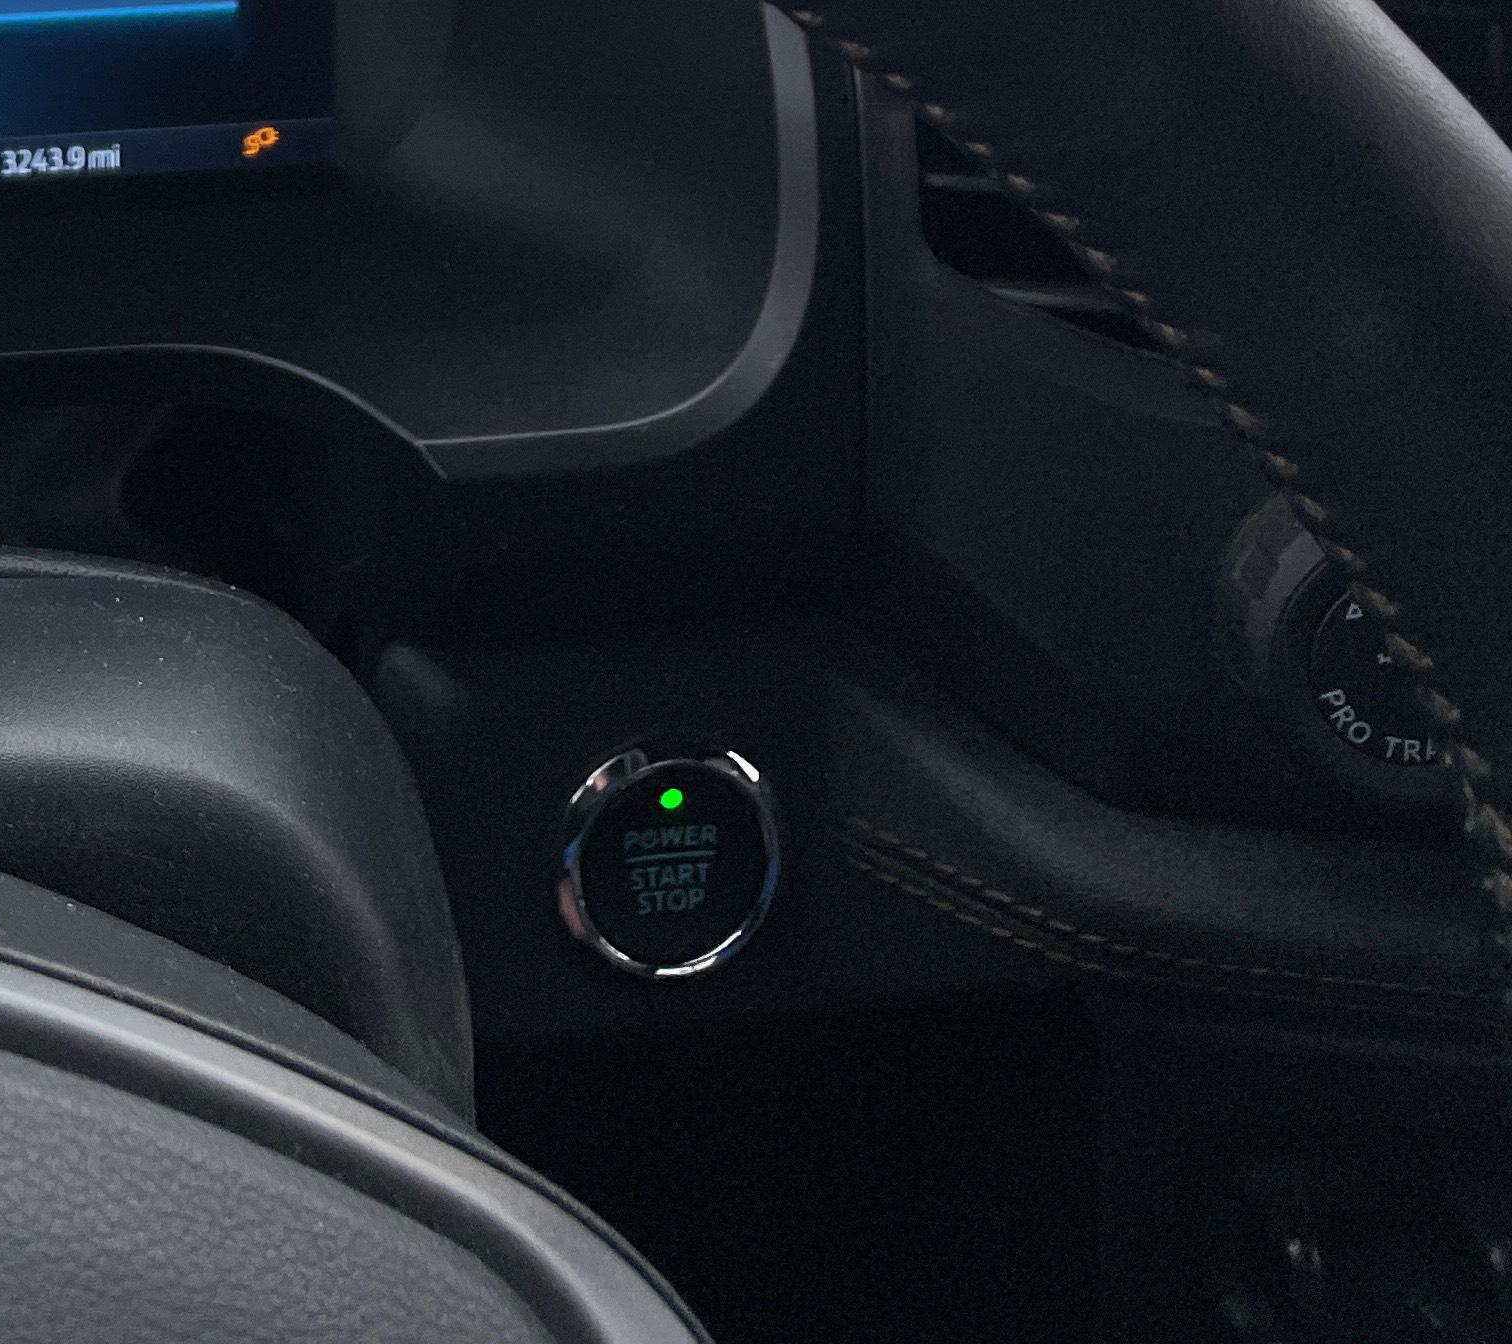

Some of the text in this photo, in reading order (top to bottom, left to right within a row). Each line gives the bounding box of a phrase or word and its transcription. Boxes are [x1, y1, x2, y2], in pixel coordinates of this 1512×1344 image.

[1319, 688, 1373, 744] PRO
[623, 823, 717, 850] POWER
[630, 861, 709, 892] START
[637, 888, 706, 916] STOP
